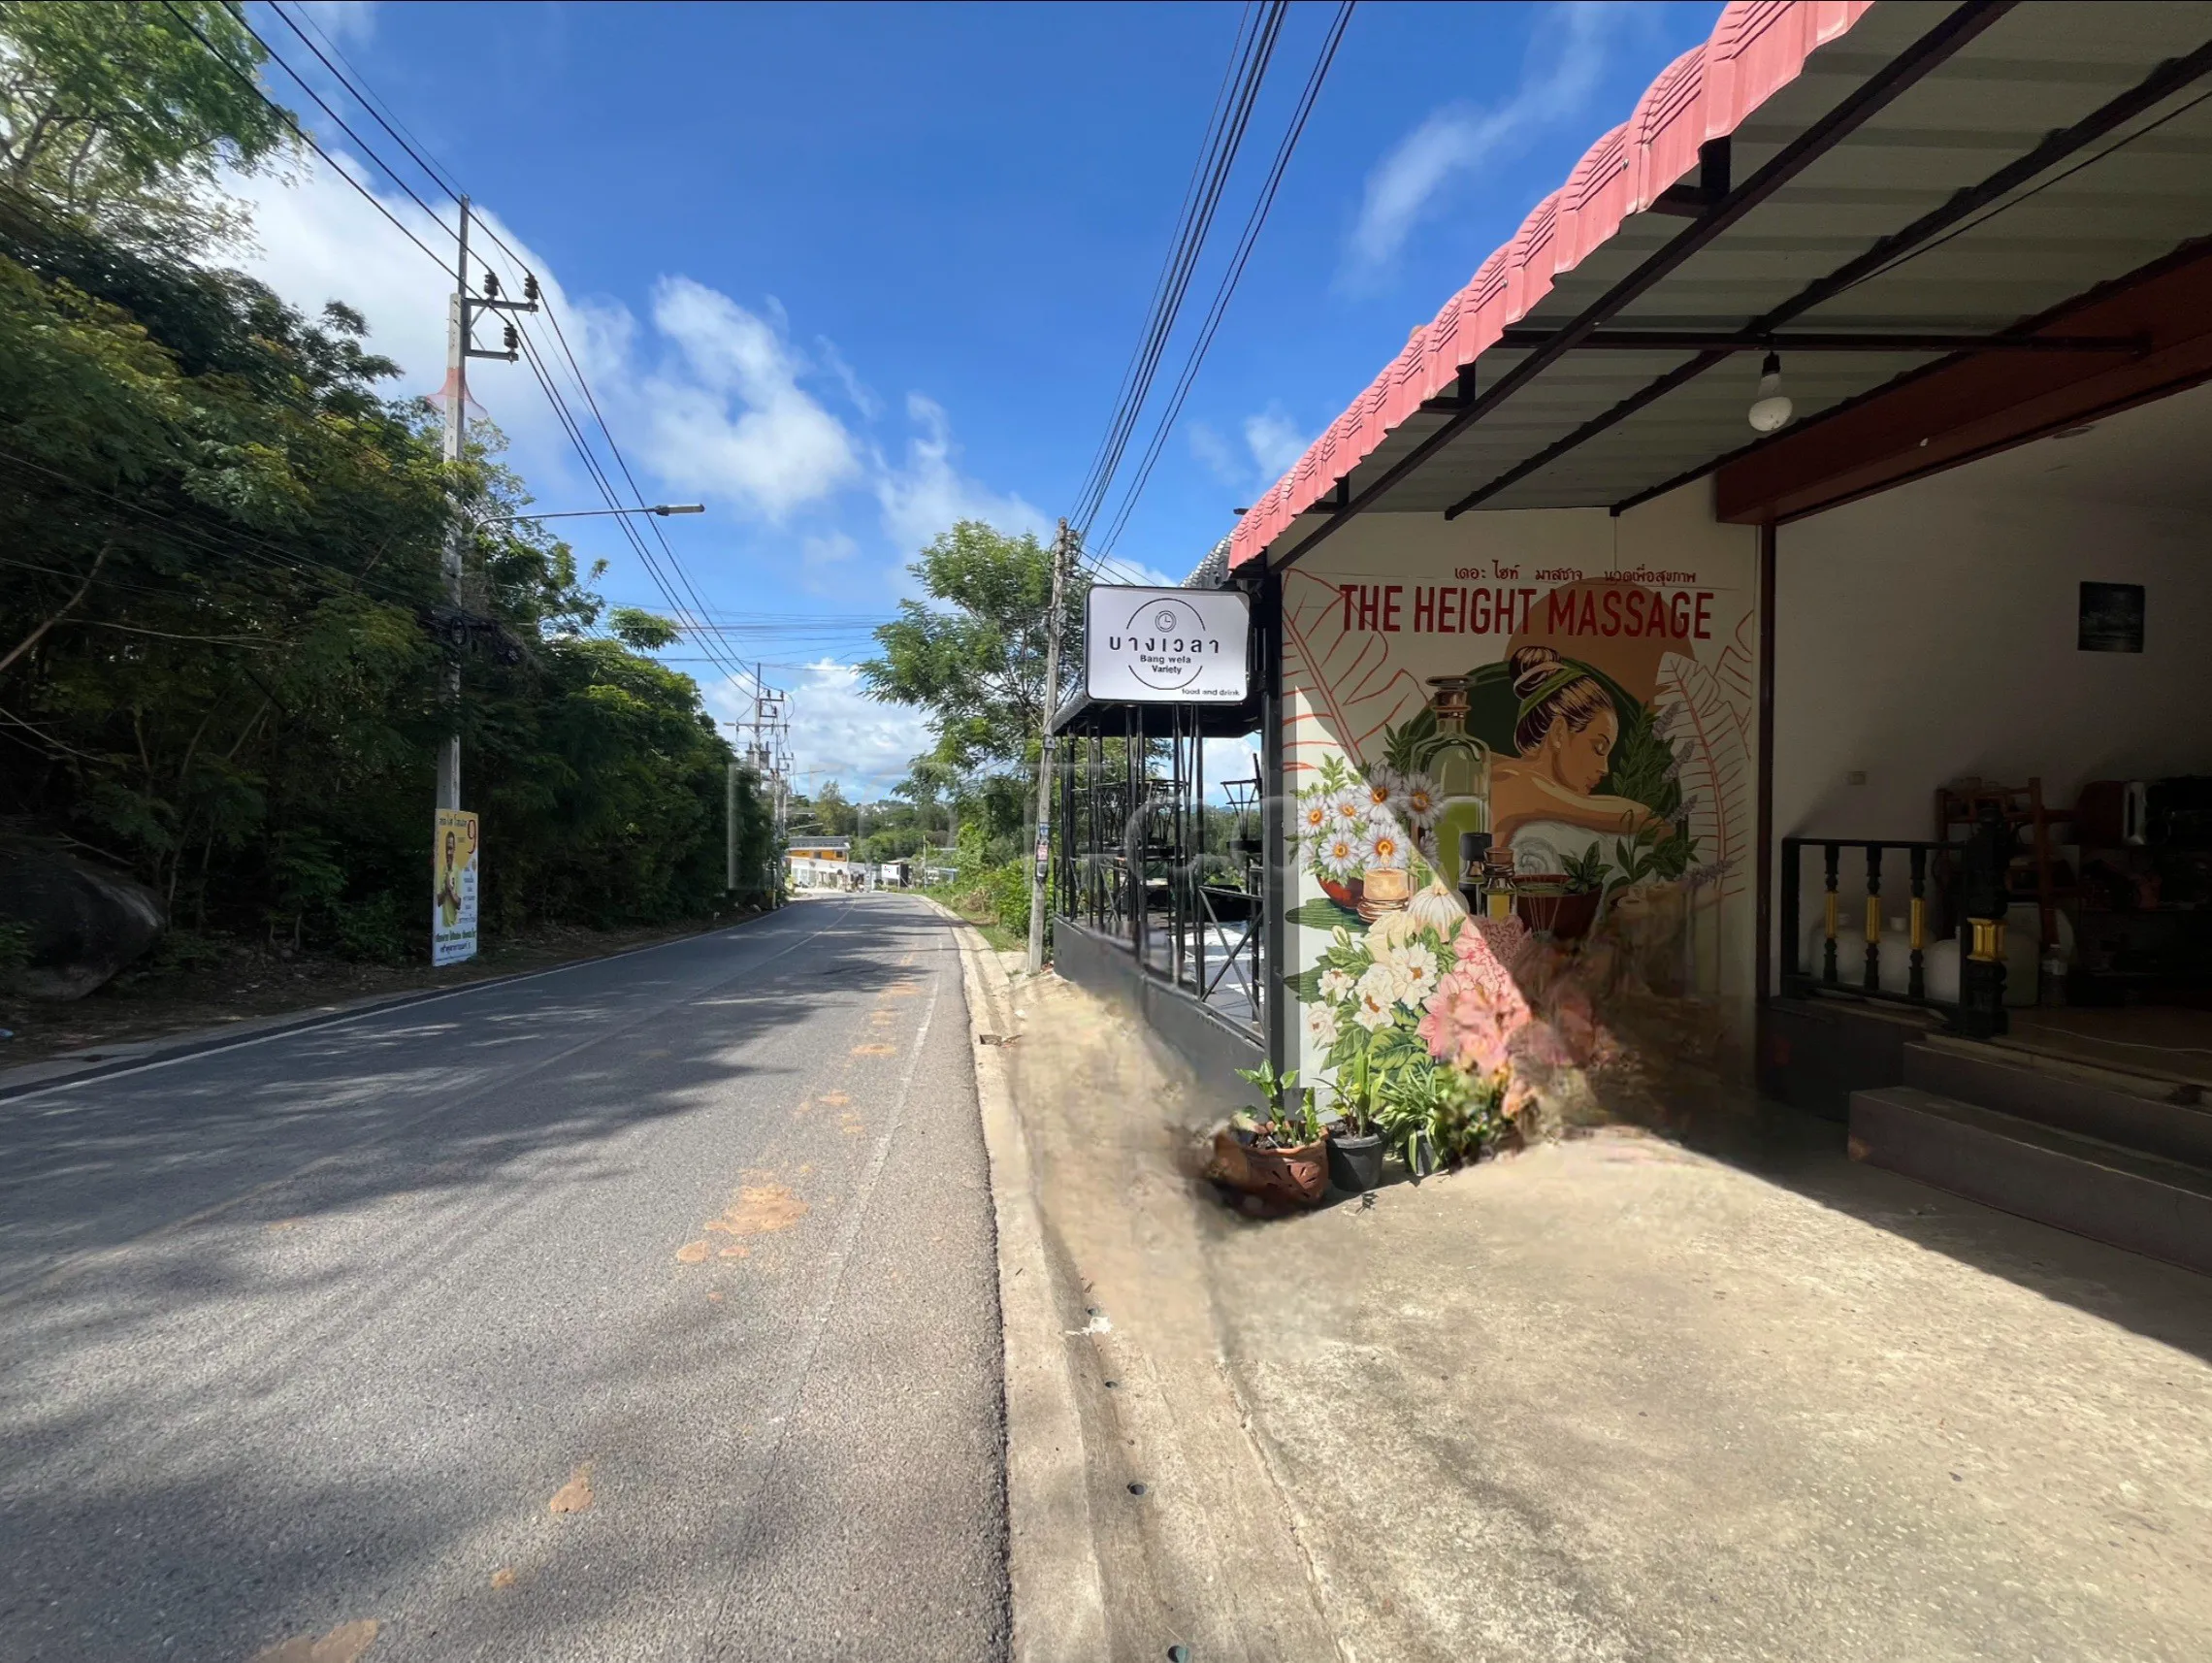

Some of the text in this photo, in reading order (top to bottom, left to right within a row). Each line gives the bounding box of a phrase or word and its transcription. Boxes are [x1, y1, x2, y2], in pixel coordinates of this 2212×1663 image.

[1454, 568, 1485, 580] เดอะ
[1491, 559, 1520, 580] ไฮท์
[1604, 563, 1696, 586] นวดเพื่อสุขภาพ
[1339, 584, 1714, 639] THE HEIGHT MASSAGE
[1109, 636, 1220, 654] บางเวลา
[1140, 654, 1191, 665] Bang wela
[1152, 665, 1183, 674] Variety
[468, 819, 477, 855] 9
